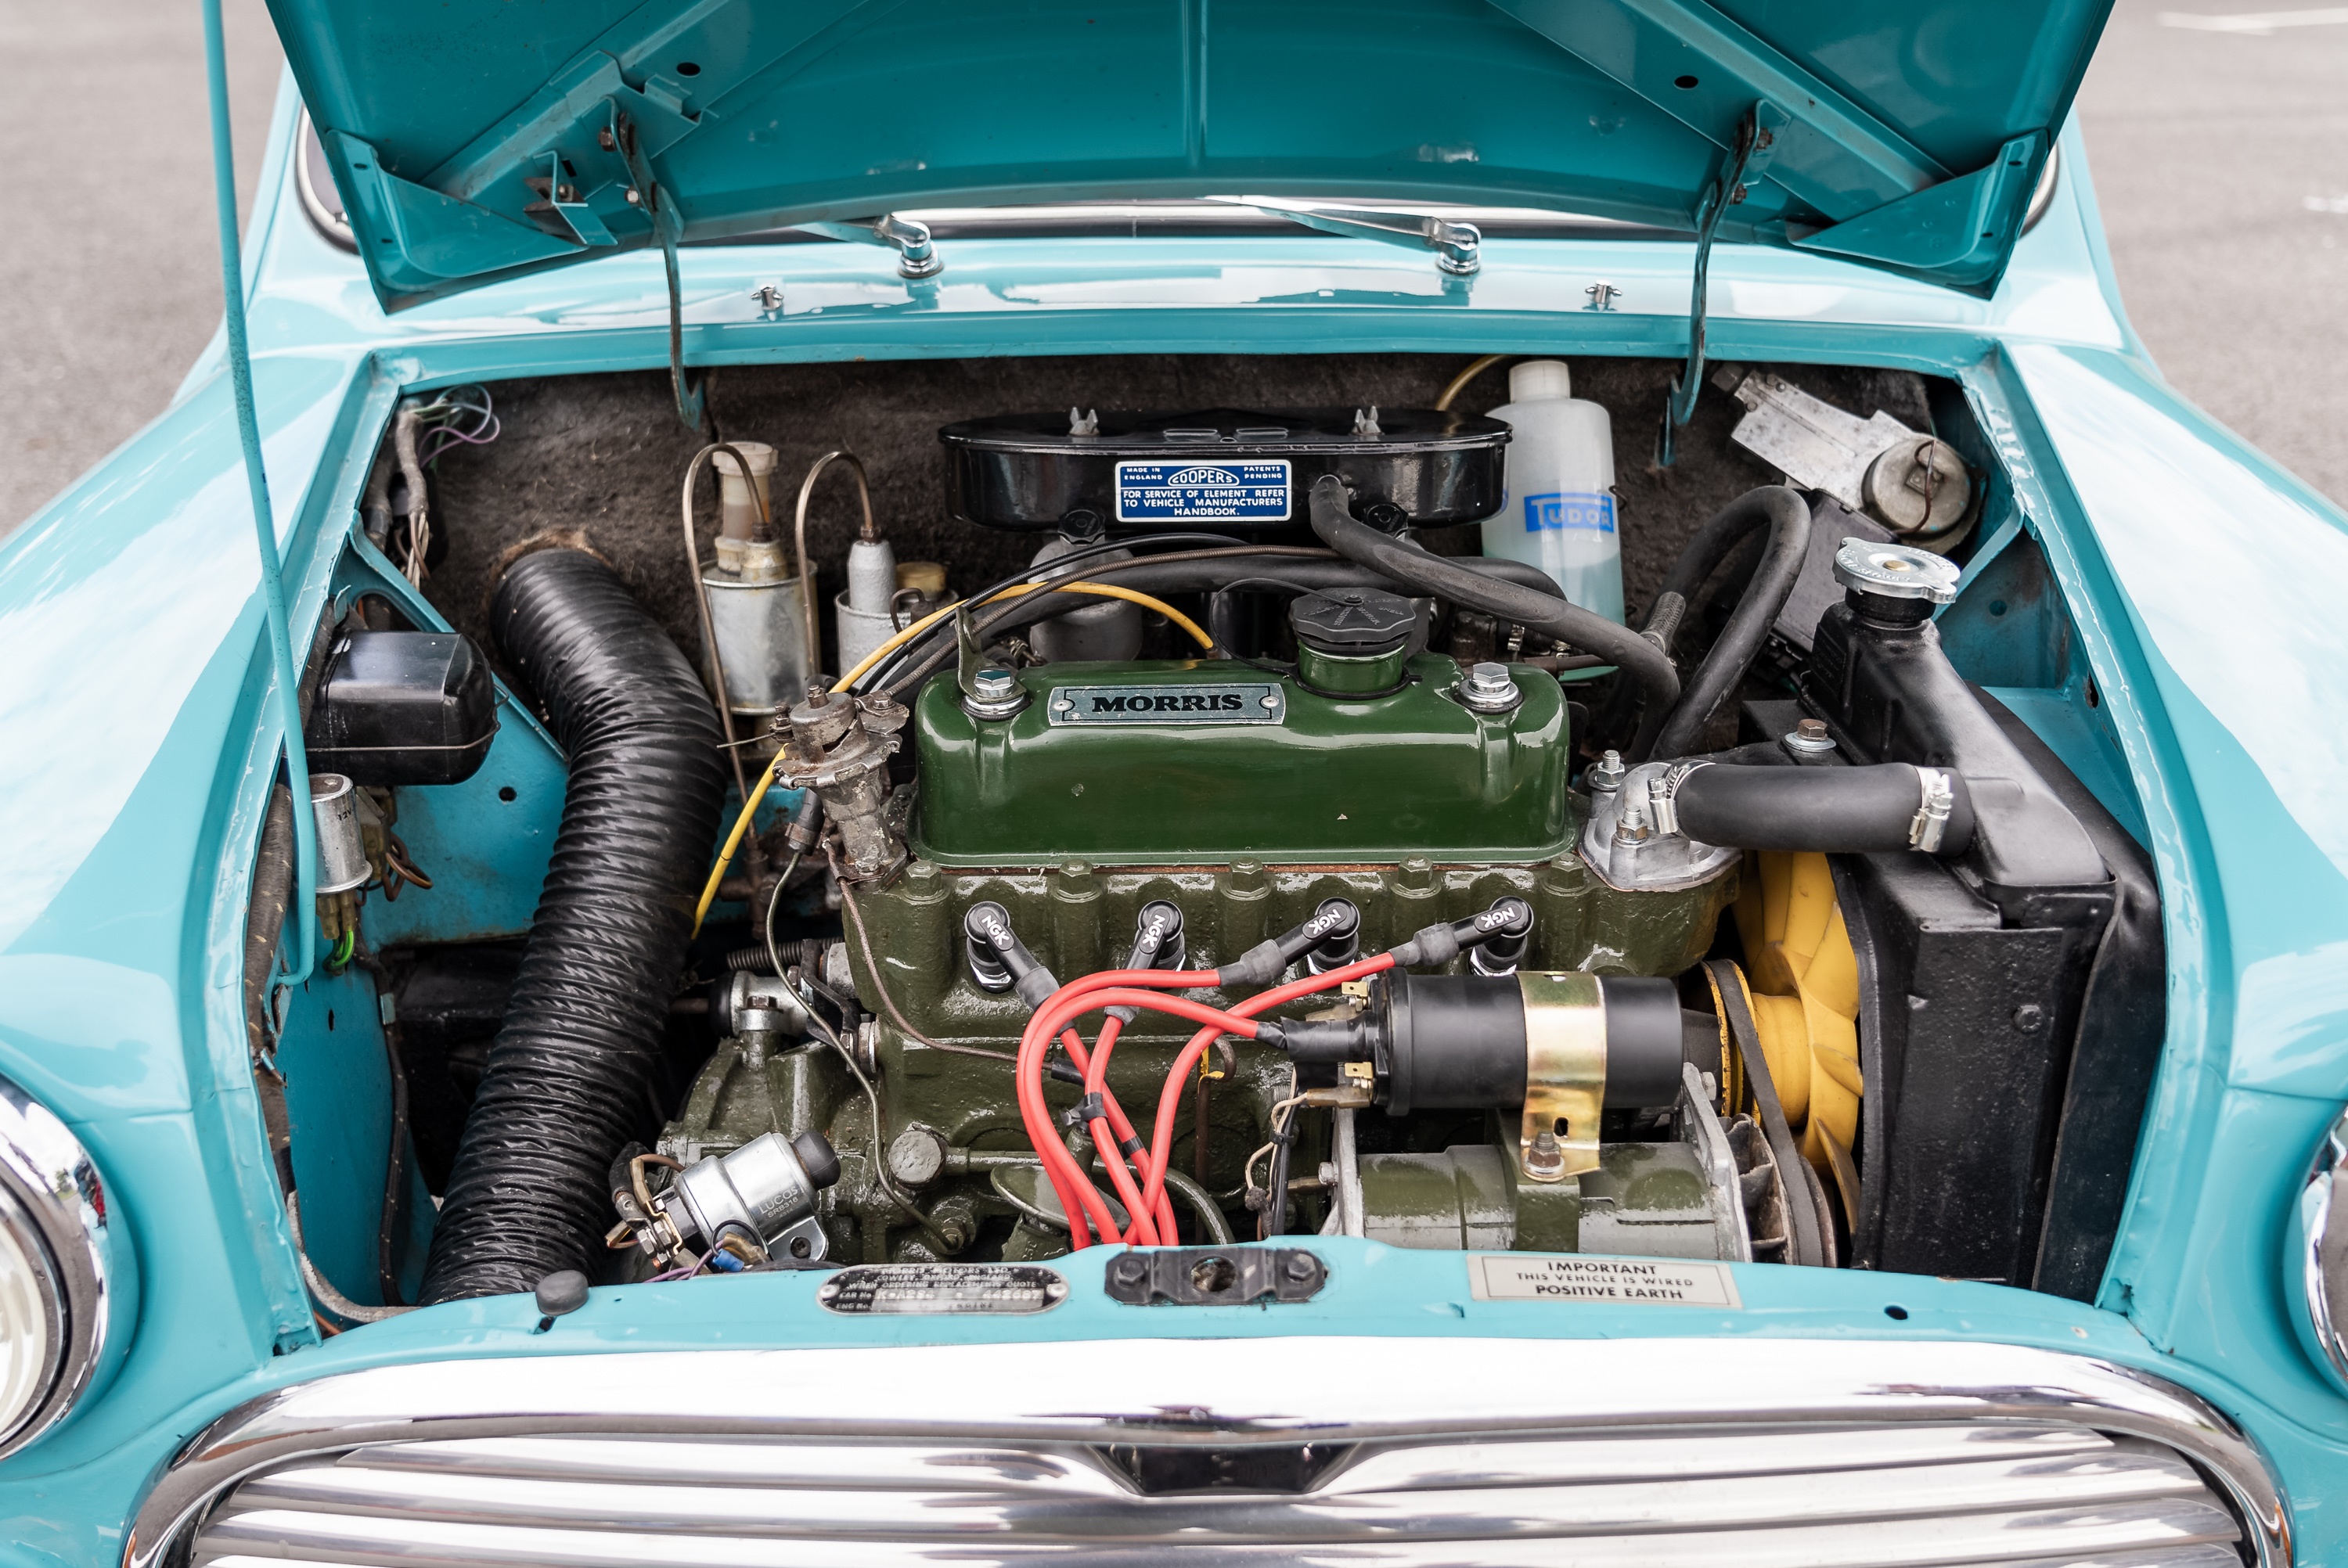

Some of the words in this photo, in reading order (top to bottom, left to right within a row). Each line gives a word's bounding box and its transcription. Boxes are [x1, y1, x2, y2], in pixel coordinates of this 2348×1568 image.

[1123, 490, 1141, 498] FOR
[1145, 490, 1182, 498] SERVICE
[1187, 489, 1199, 498] OF
[1205, 489, 1247, 498] ELEMENT
[1143, 498, 1185, 507] VEHICLE
[1195, 498, 1283, 506] MANUFACTURERS
[1174, 507, 1241, 516] HANDBOOK.
[1091, 694, 1244, 713] MORRIS
[1308, 908, 1341, 935] NGK
[1480, 907, 1515, 929] NGK
[981, 915, 1010, 946] NGK
[1142, 914, 1166, 948] NGK
[1547, 1261, 1656, 1275] IMPORTANT
[1516, 1272, 1549, 1281] THIS
[1556, 1274, 1616, 1283] VEHICLE
[1643, 1277, 1693, 1286] WIRED
[1535, 1284, 1616, 1296] POSITIVE
[1625, 1287, 1683, 1299] EARTH
